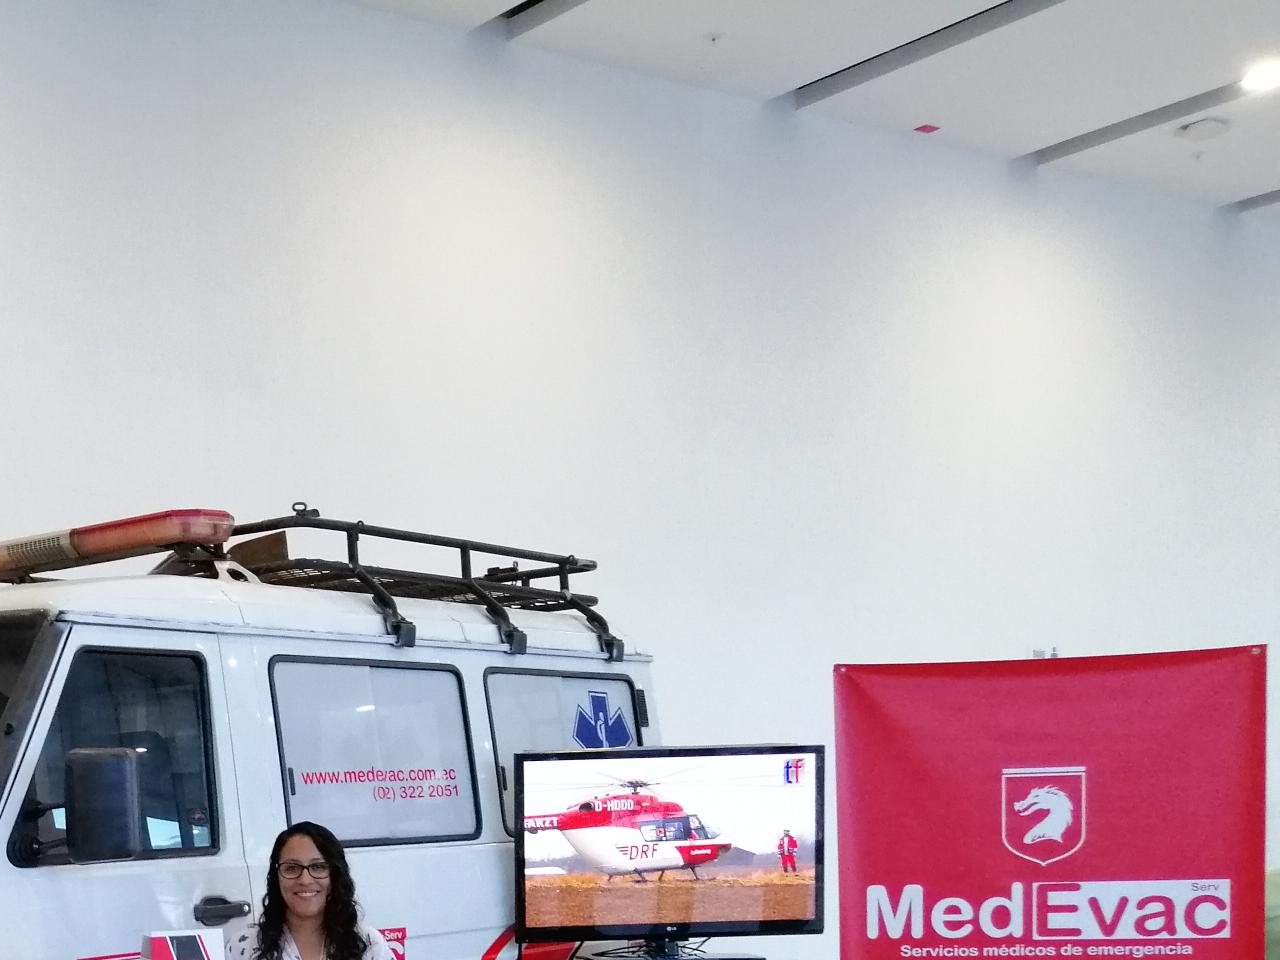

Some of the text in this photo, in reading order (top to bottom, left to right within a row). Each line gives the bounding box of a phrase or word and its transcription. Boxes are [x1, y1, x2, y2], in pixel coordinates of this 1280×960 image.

[400, 786, 424, 798] 322
[428, 784, 458, 797] 2051
[629, 844, 659, 860] DRF
[1191, 882, 1220, 892] Serv
[866, 882, 1229, 939] MedEvac
[385, 931, 402, 939] Serv
[900, 942, 1193, 958] Servicios médicos de emergencia
